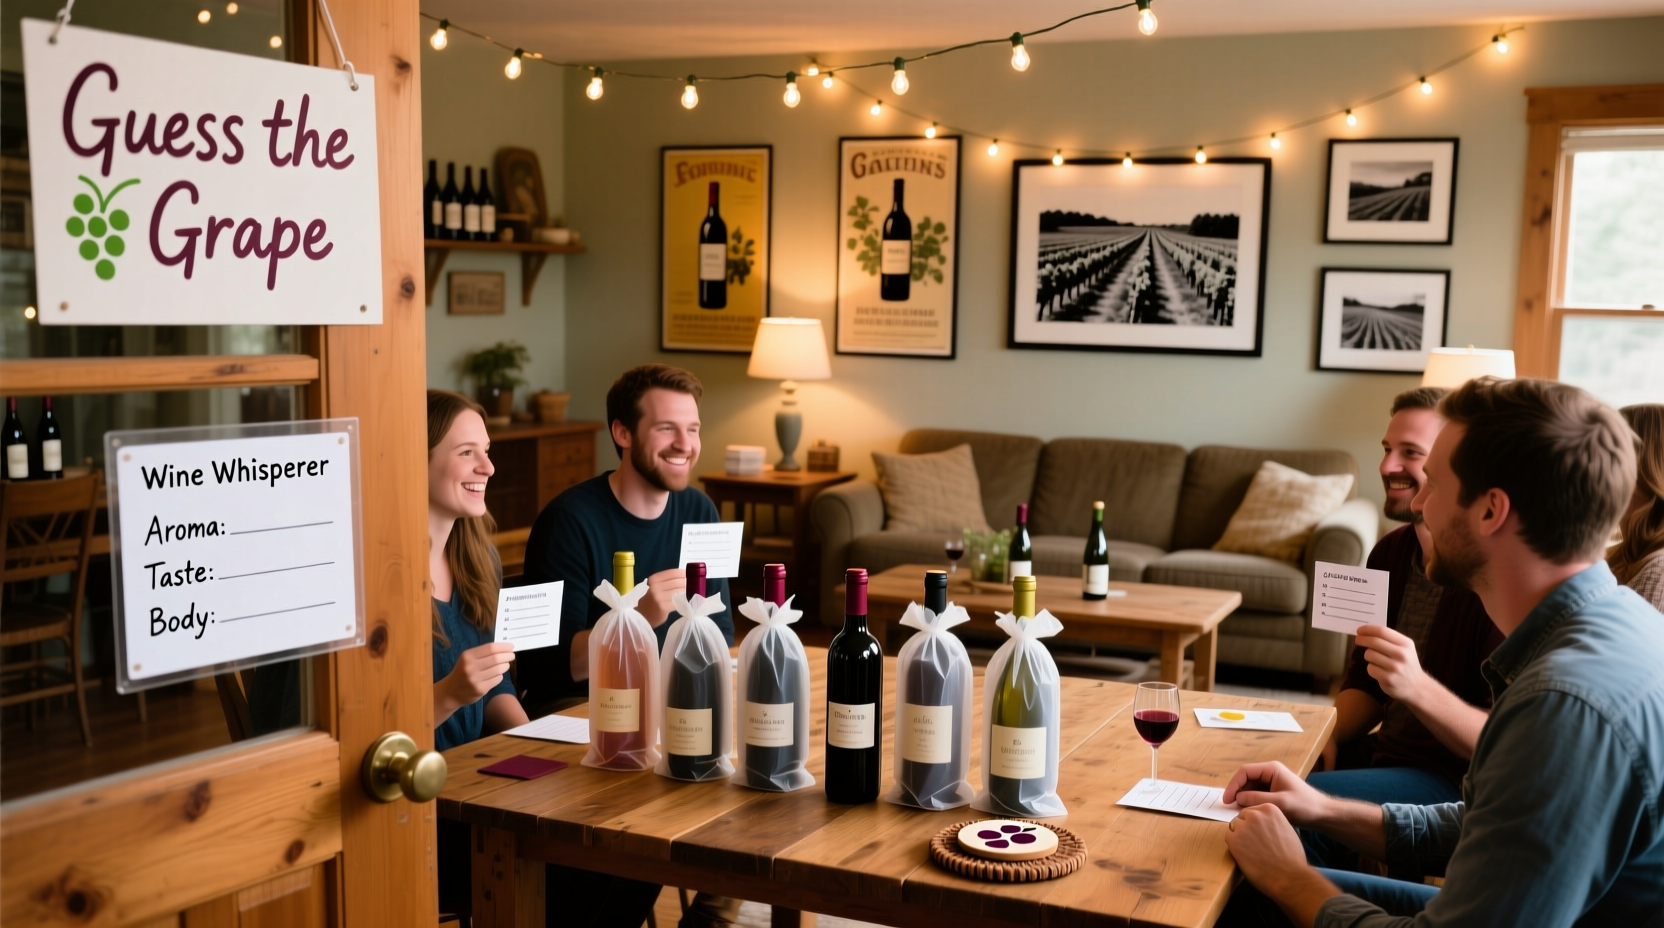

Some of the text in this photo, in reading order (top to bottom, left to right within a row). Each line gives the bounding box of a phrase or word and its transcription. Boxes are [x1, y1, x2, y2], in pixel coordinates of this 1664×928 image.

[63, 62, 355, 177] Guess the
[149, 180, 333, 291] Grape
[141, 457, 329, 490] Wine Whisperer
[144, 515, 226, 546] Aroma:
[144, 560, 214, 589] Taste:
[150, 602, 216, 639] Body:
